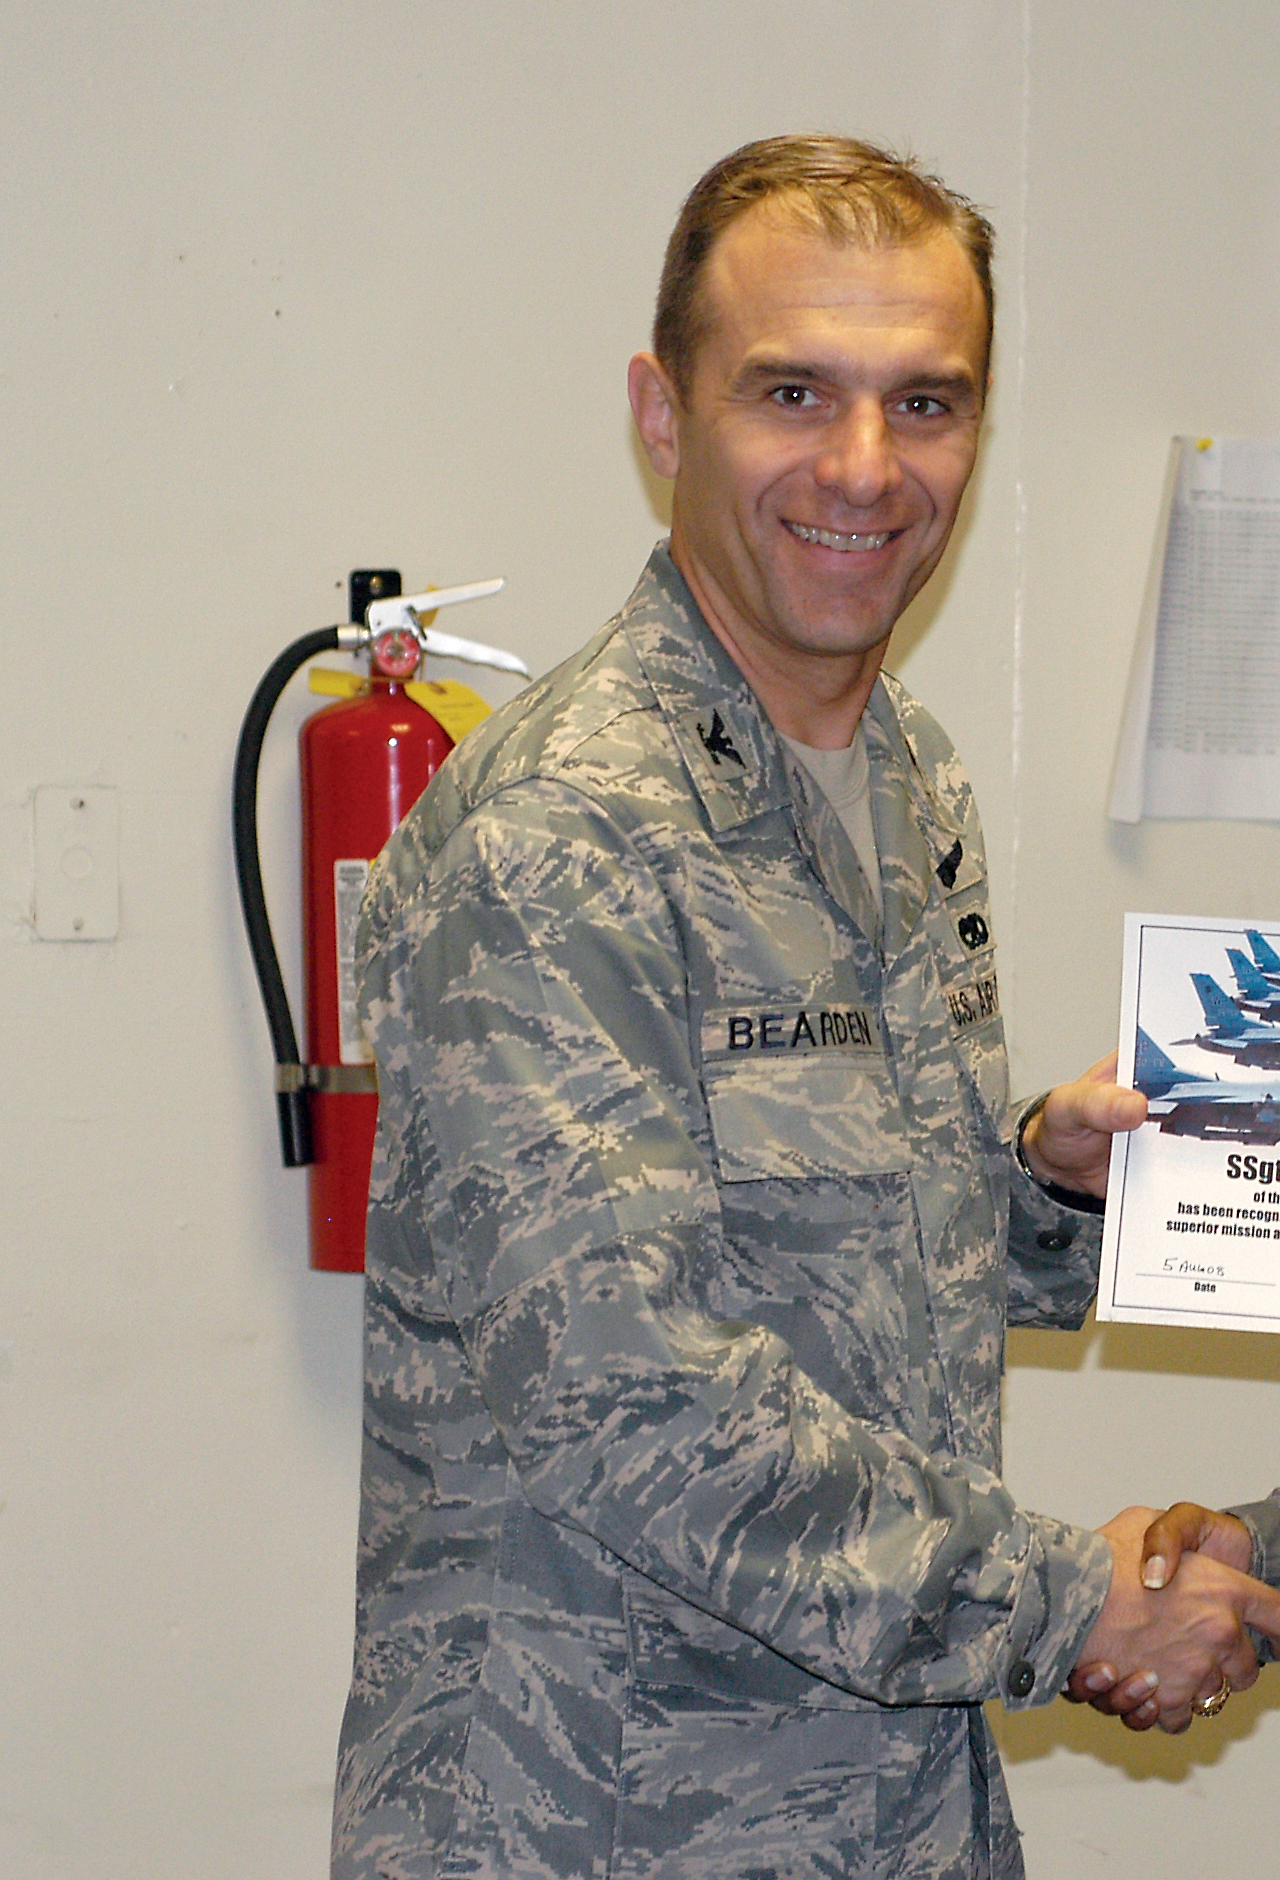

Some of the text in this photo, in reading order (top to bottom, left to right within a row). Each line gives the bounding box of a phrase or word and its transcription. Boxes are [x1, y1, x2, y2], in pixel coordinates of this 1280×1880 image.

[728, 1011, 872, 1050] BEARDEN
[1253, 1191, 1266, 1203] of
[1177, 1201, 1200, 1215] has
[1202, 1203, 1234, 1218] been
[1166, 1219, 1220, 1236] superior
[1221, 1223, 1271, 1239] mission
[1163, 1257, 1178, 1271] 5
[1194, 1282, 1217, 1293] Date
